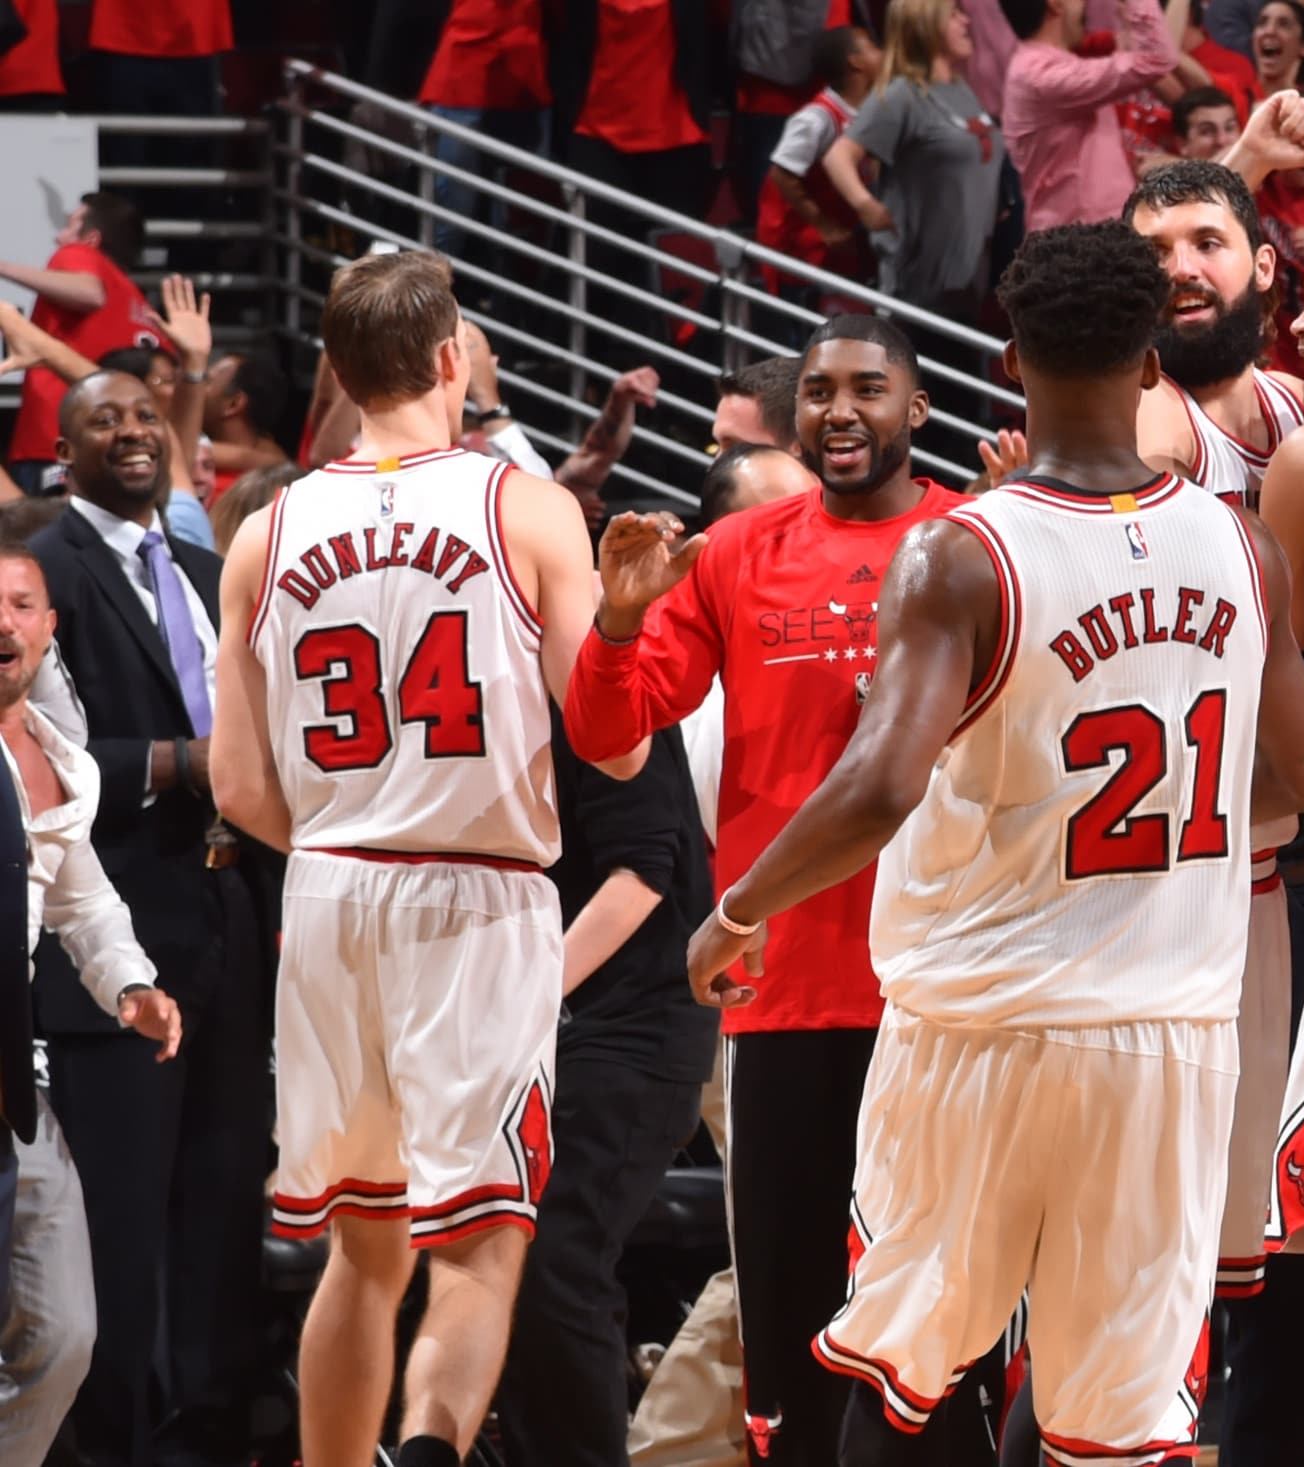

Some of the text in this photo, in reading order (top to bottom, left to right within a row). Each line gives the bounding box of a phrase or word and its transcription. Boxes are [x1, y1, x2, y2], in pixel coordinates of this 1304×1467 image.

[277, 522, 490, 611] DUNLEAVY
[758, 606, 835, 647] SEE
[1049, 586, 1237, 683] BUTLER
[293, 610, 487, 773] 34
[1060, 688, 1228, 880] 21
